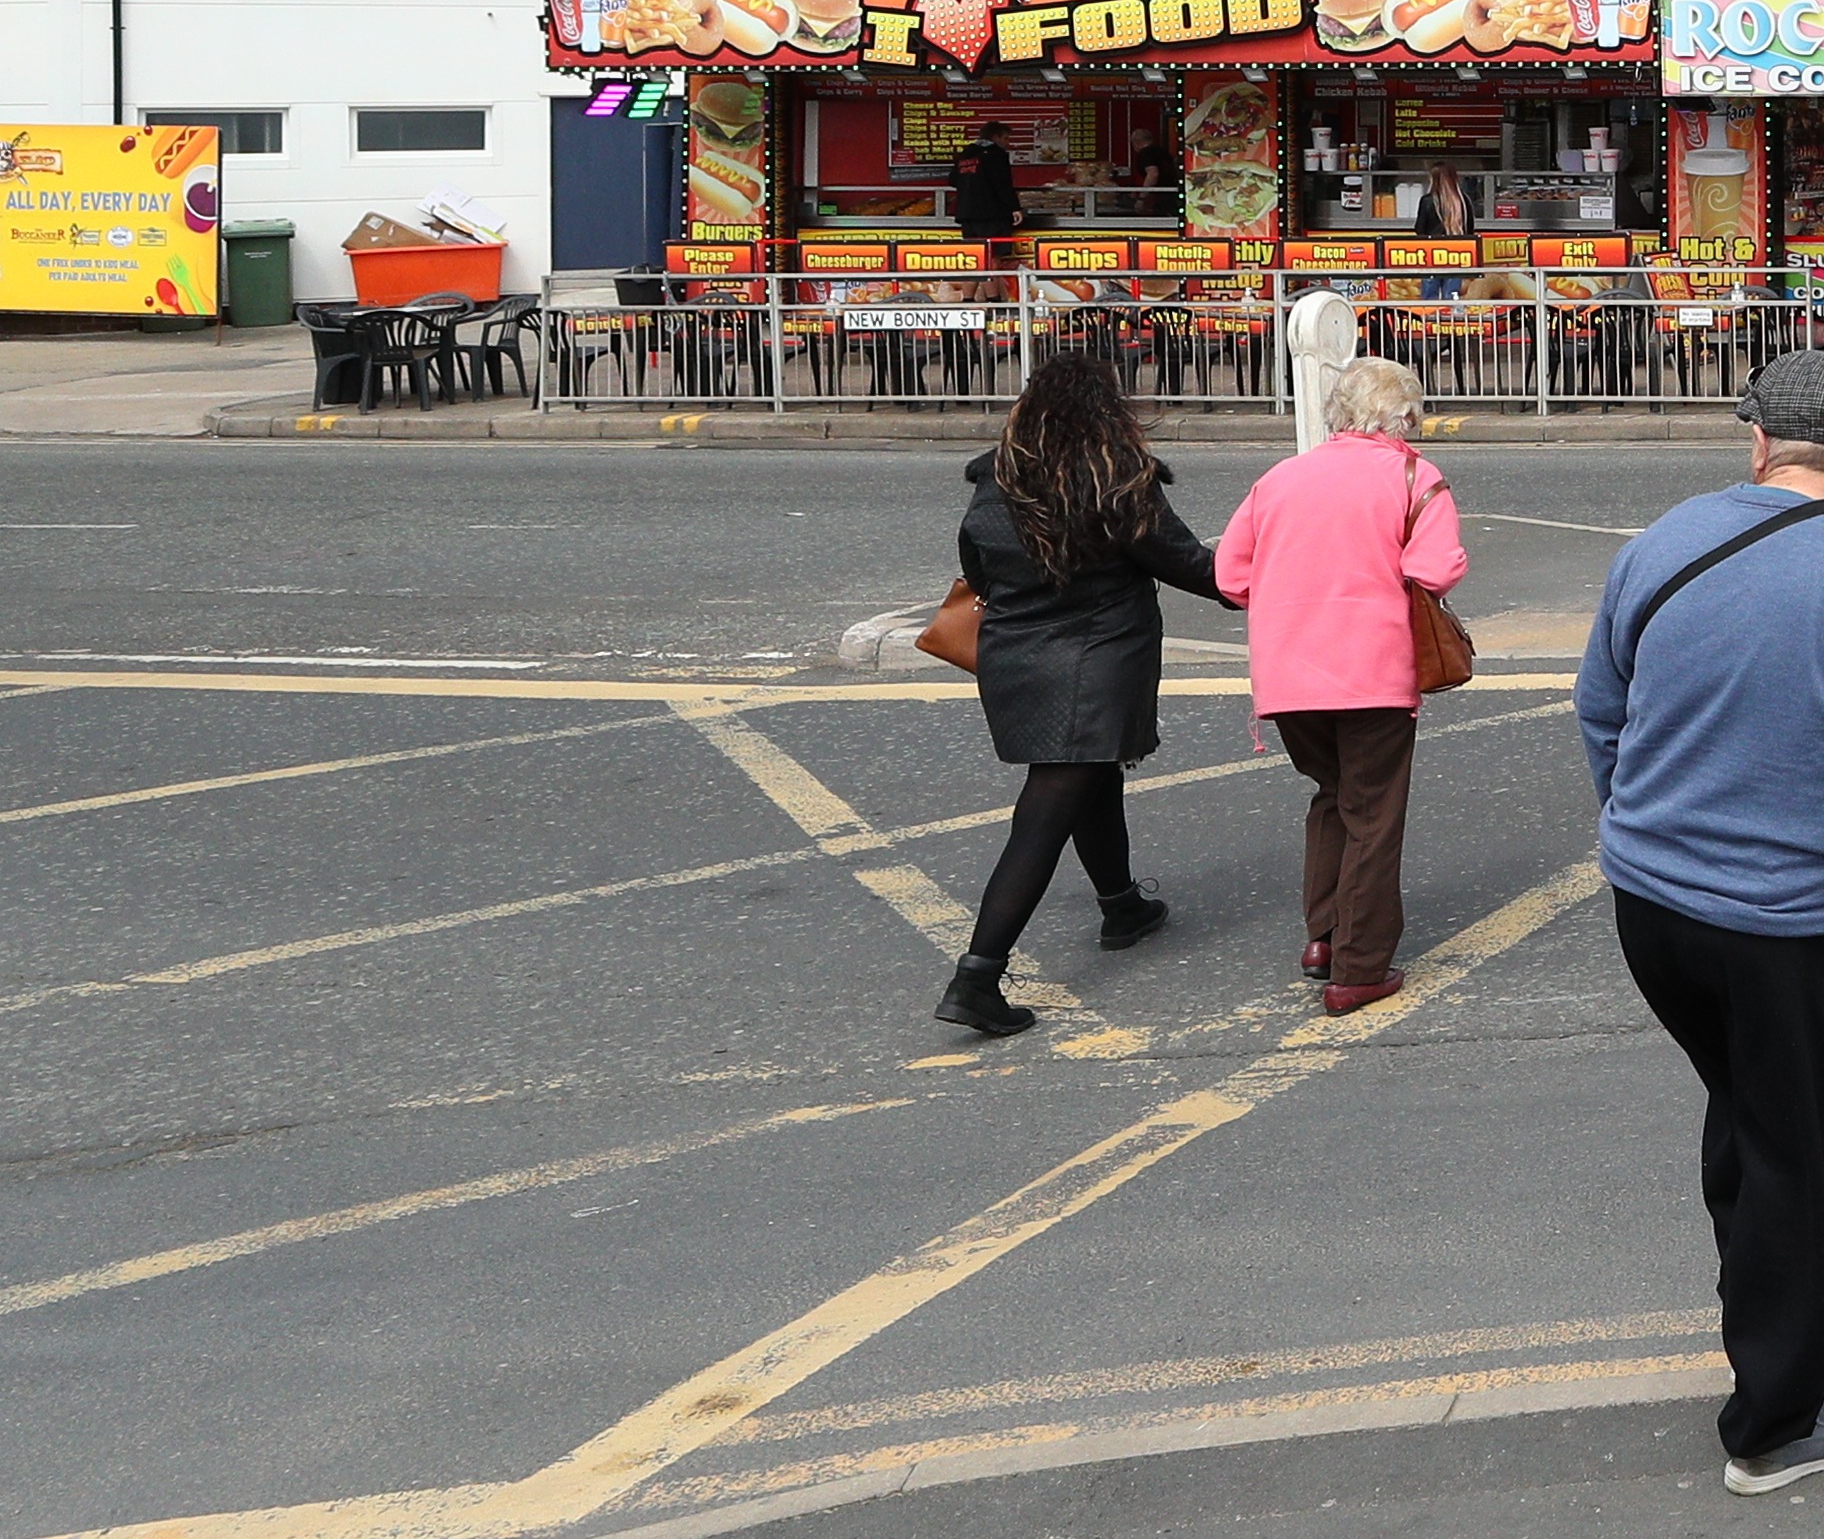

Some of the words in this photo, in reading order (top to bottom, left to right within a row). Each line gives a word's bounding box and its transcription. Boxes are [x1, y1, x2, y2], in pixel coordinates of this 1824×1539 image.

[863, 10, 922, 67] I
[1680, 64, 1754, 93] ICE
[1395, 109, 1418, 117] Latte
[1413, 129, 1457, 138] Chocolate
[6, 191, 35, 210] ALL
[40, 191, 77, 212] DAY,
[81, 191, 134, 212] EVERY
[138, 192, 171, 212] DAY
[11, 228, 65, 241] BUCCANEER
[692, 222, 763, 241] Burgers
[683, 249, 735, 263] Please
[1155, 244, 1212, 260] Nutella
[1313, 245, 1346, 260] Bacon
[1563, 241, 1594, 257] Exit
[1680, 237, 1731, 262] Hot
[1733, 237, 1756, 261] &
[52, 258, 69, 267] FREE
[119, 260, 139, 269] MEAL
[806, 254, 884, 270] Cheeseburger
[905, 252, 978, 270] Donuts
[1049, 248, 1118, 271] Chips
[1156, 260, 1212, 271] Donuts
[1292, 259, 1368, 270] Cheeseburger
[1390, 249, 1426, 267] Hot
[1434, 249, 1472, 268] Dog
[688, 263, 729, 274] Enter
[1688, 263, 1746, 287] Cold
[49, 272, 63, 281] PER
[108, 273, 128, 282] MEAL
[575, 318, 624, 332] Donuts
[849, 312, 885, 328] NEW
[894, 312, 950, 328] BONNY
[960, 311, 982, 327] ST
[1214, 320, 1250, 332] Chips
[1014, 321, 1048, 334] Dgs
[1431, 322, 1484, 335] Burgers
